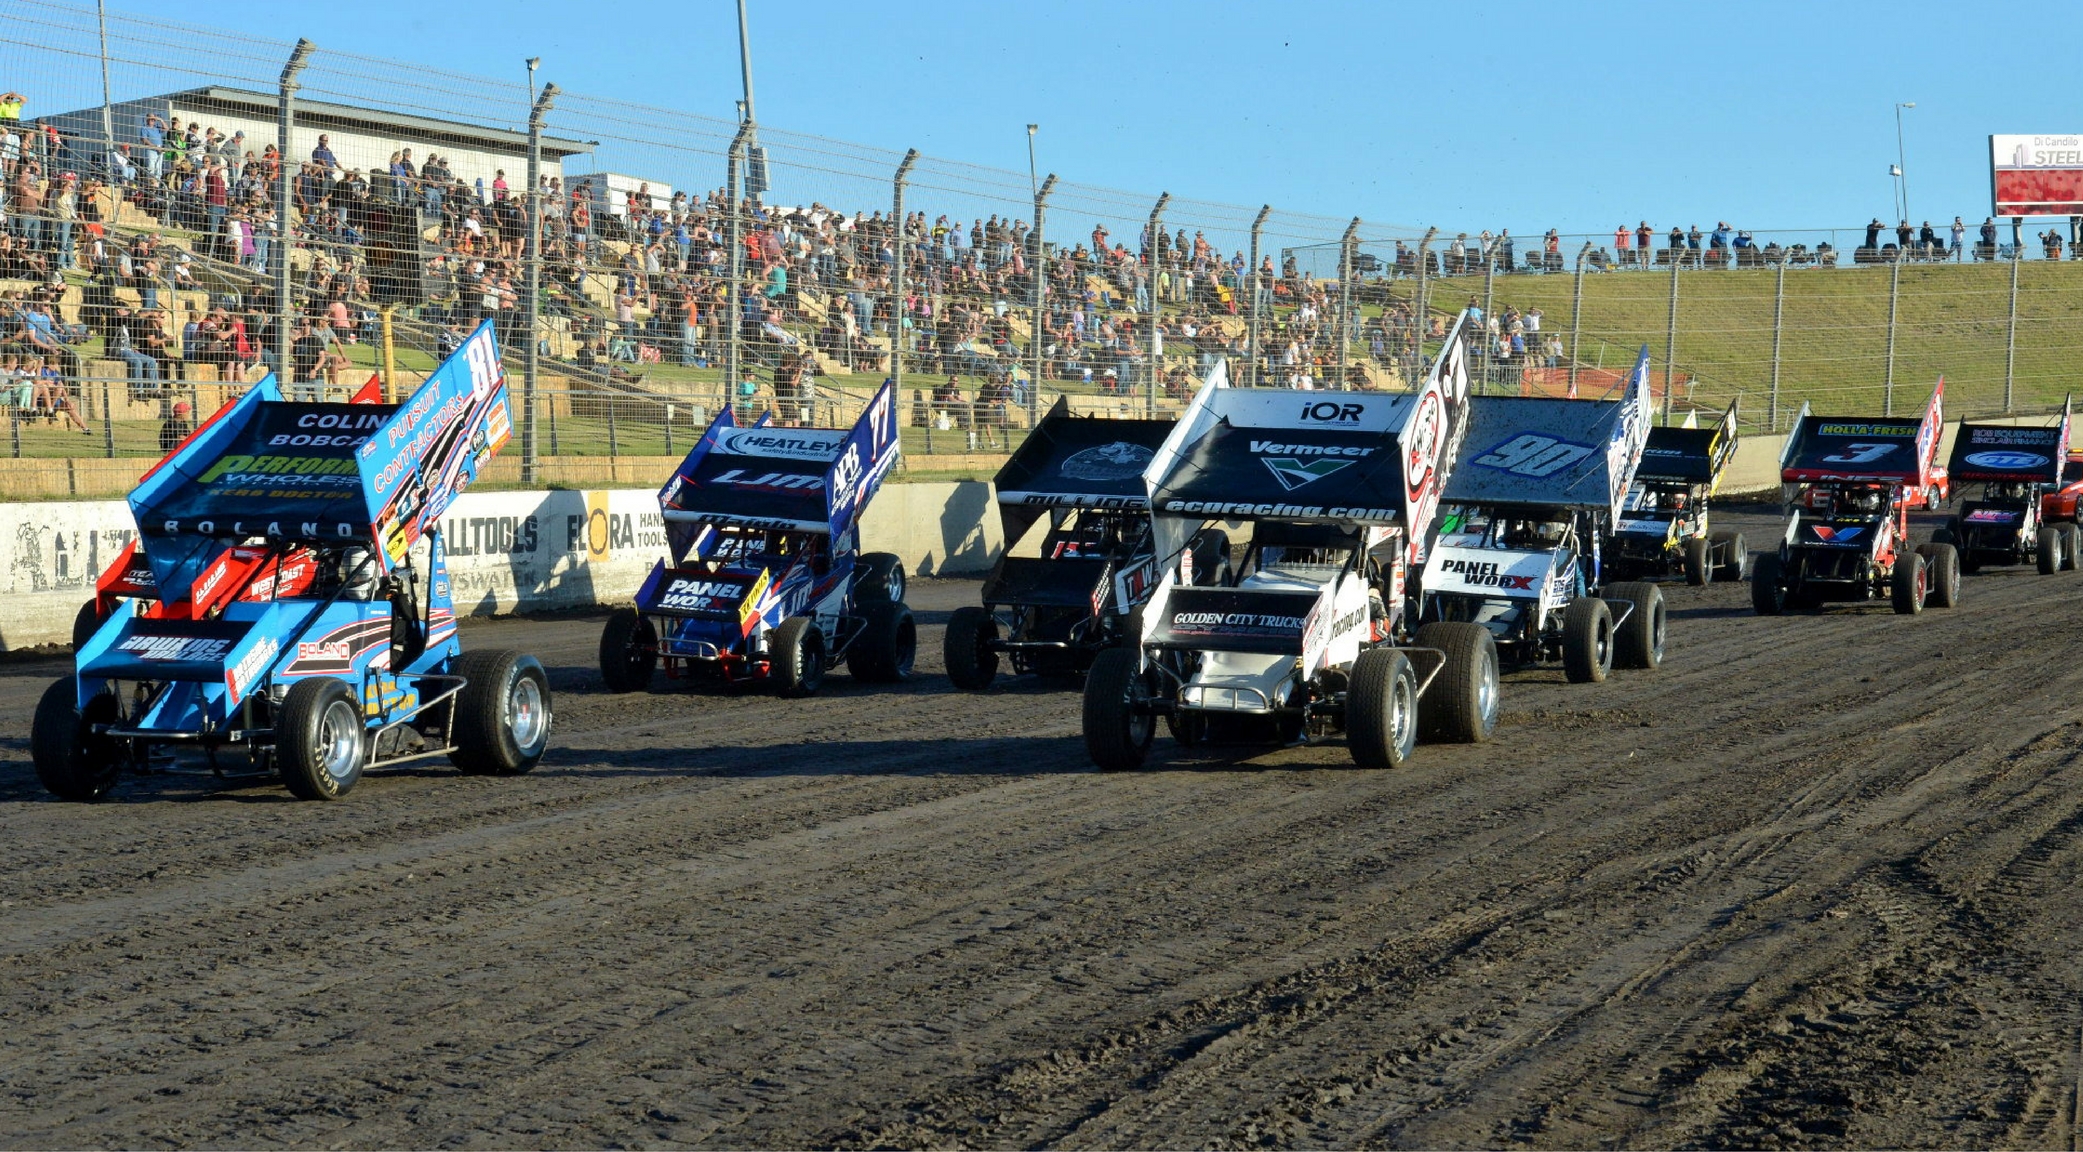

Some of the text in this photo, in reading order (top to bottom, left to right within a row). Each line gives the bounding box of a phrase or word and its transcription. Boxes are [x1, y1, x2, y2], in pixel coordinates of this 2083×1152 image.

[2034, 150, 2083, 165] STEEL
[466, 328, 499, 402] 81
[298, 413, 390, 429] COLIN
[869, 385, 891, 462] 77
[1250, 440, 1375, 457] Vermeer
[1472, 433, 1596, 478] 90
[1165, 500, 1397, 521] ecpracing.com
[165, 520, 352, 538] BOLAND
[129, 570, 155, 578] TEA
[279, 563, 306, 585] OAST
[1441, 559, 1499, 575] PANEL
[667, 579, 744, 599] PANEL
[1464, 573, 1538, 590] WORX
[661, 593, 724, 609] WORX
[1174, 612, 1306, 629] GOLDEN CITY TRUCKS
[298, 643, 350, 659] BOLAND
